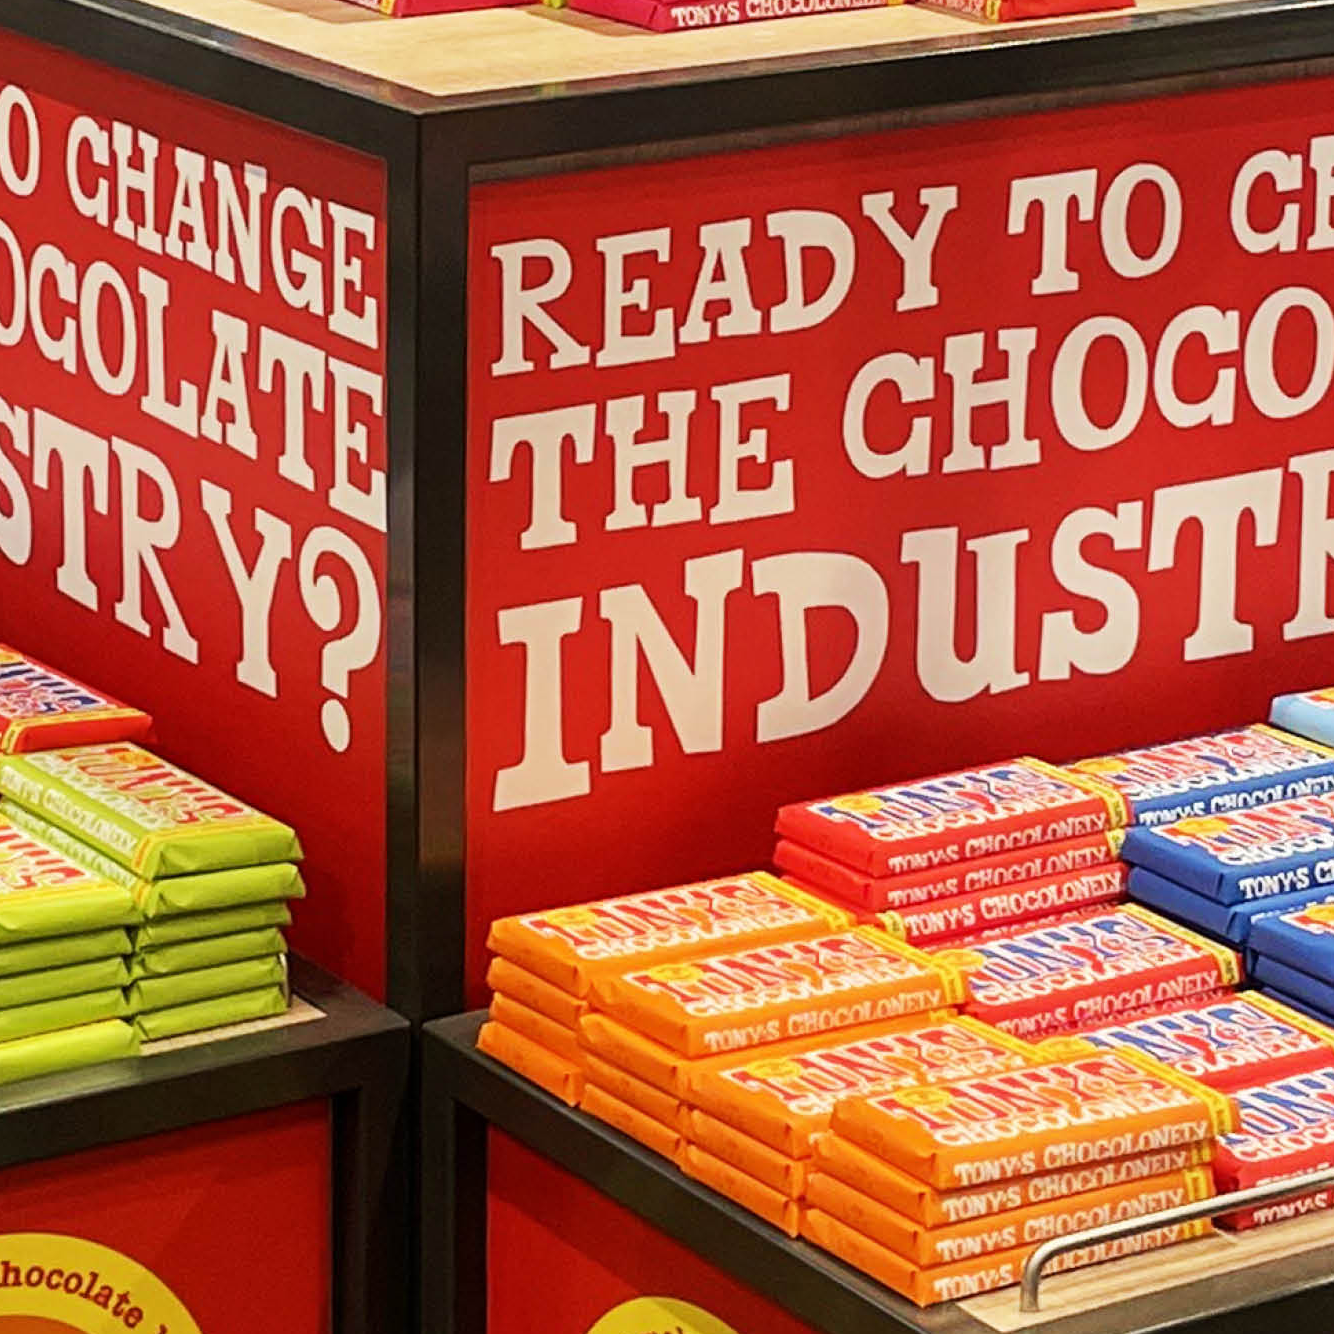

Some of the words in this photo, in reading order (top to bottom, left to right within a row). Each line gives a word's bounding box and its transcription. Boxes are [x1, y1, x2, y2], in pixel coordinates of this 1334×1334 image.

[671, 0, 740, 28] TONY'S
[67, 114, 379, 350] CHANGE
[488, 186, 960, 378] READY
[1007, 162, 1183, 296] TO
[488, 373, 795, 552] THE
[1240, 864, 1309, 899] TONY'S
[954, 1151, 1037, 1185] TONY'S
[942, 1190, 1022, 1224] TONY'S
[936, 1227, 1019, 1263] TONY'S
[934, 1265, 1014, 1300] TONY'S
